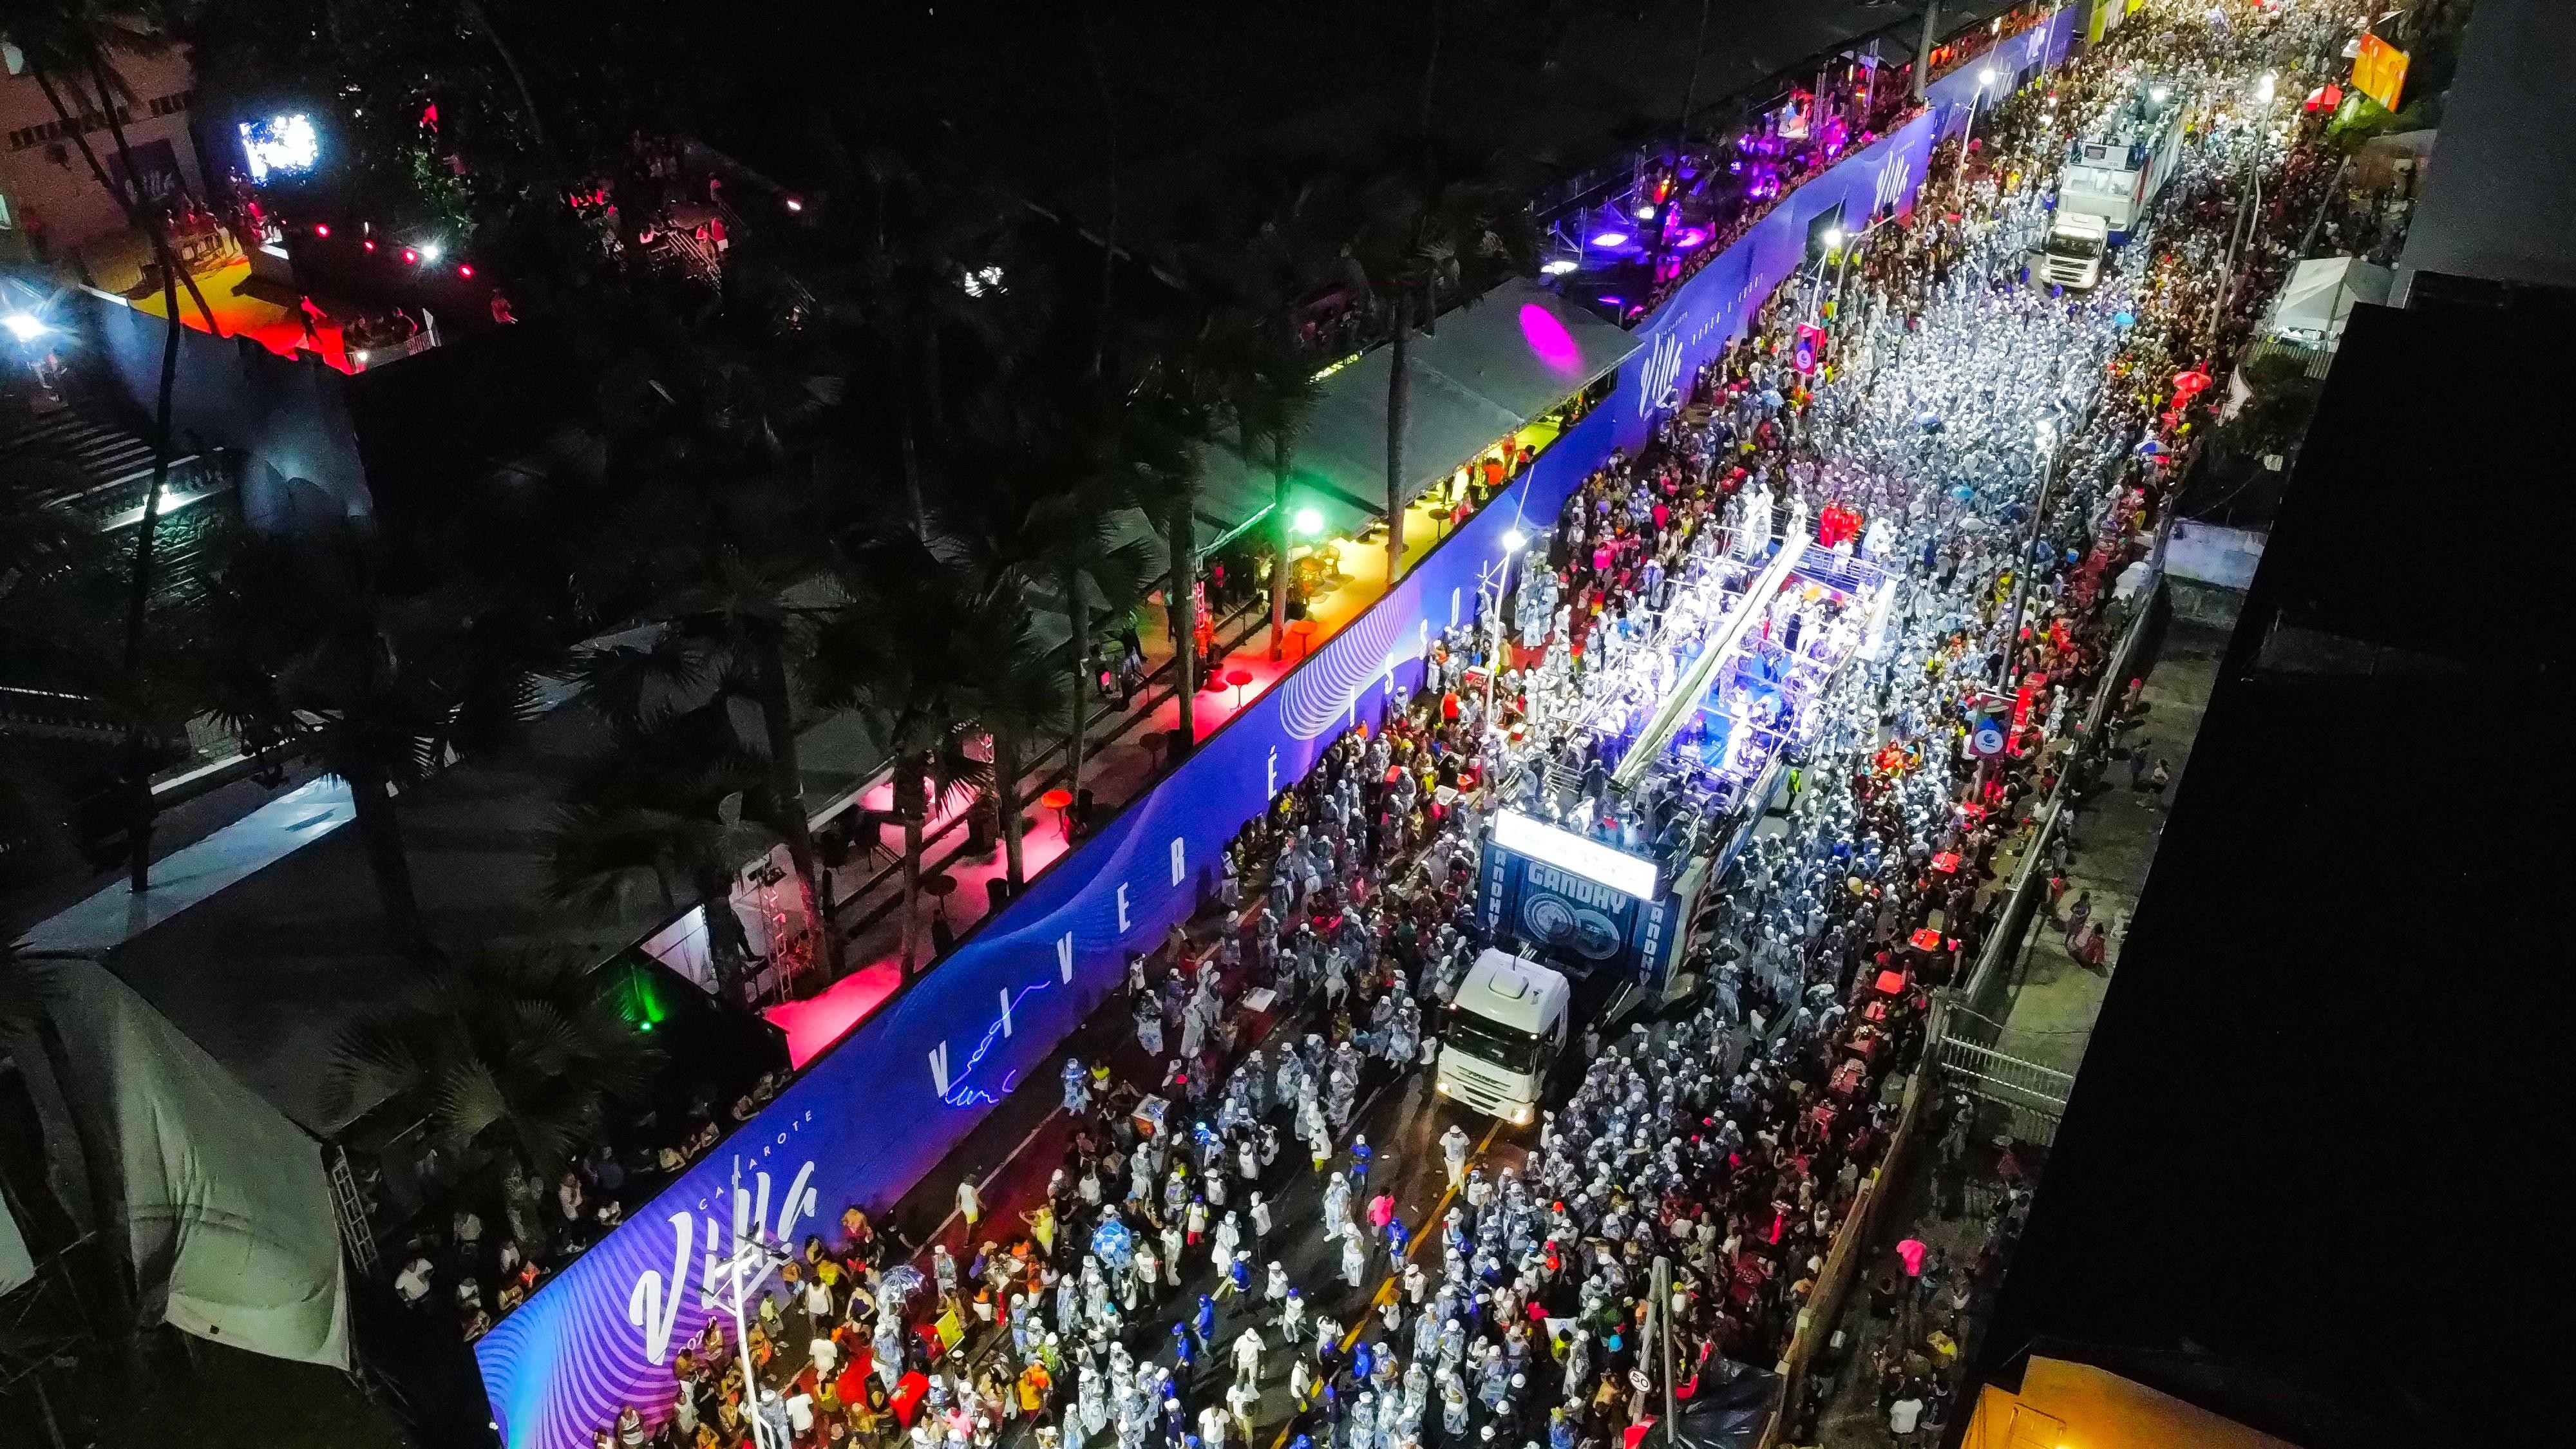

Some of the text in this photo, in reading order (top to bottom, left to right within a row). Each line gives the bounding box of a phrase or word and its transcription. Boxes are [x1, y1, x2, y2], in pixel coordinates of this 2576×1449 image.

[929, 837, 1186, 1098] VIVER
[1267, 745, 1278, 802] É
[1528, 862, 1627, 914] GANDHY
[1639, 895, 1667, 985] ANDHY
[1631, 1372, 1649, 1388] 50
